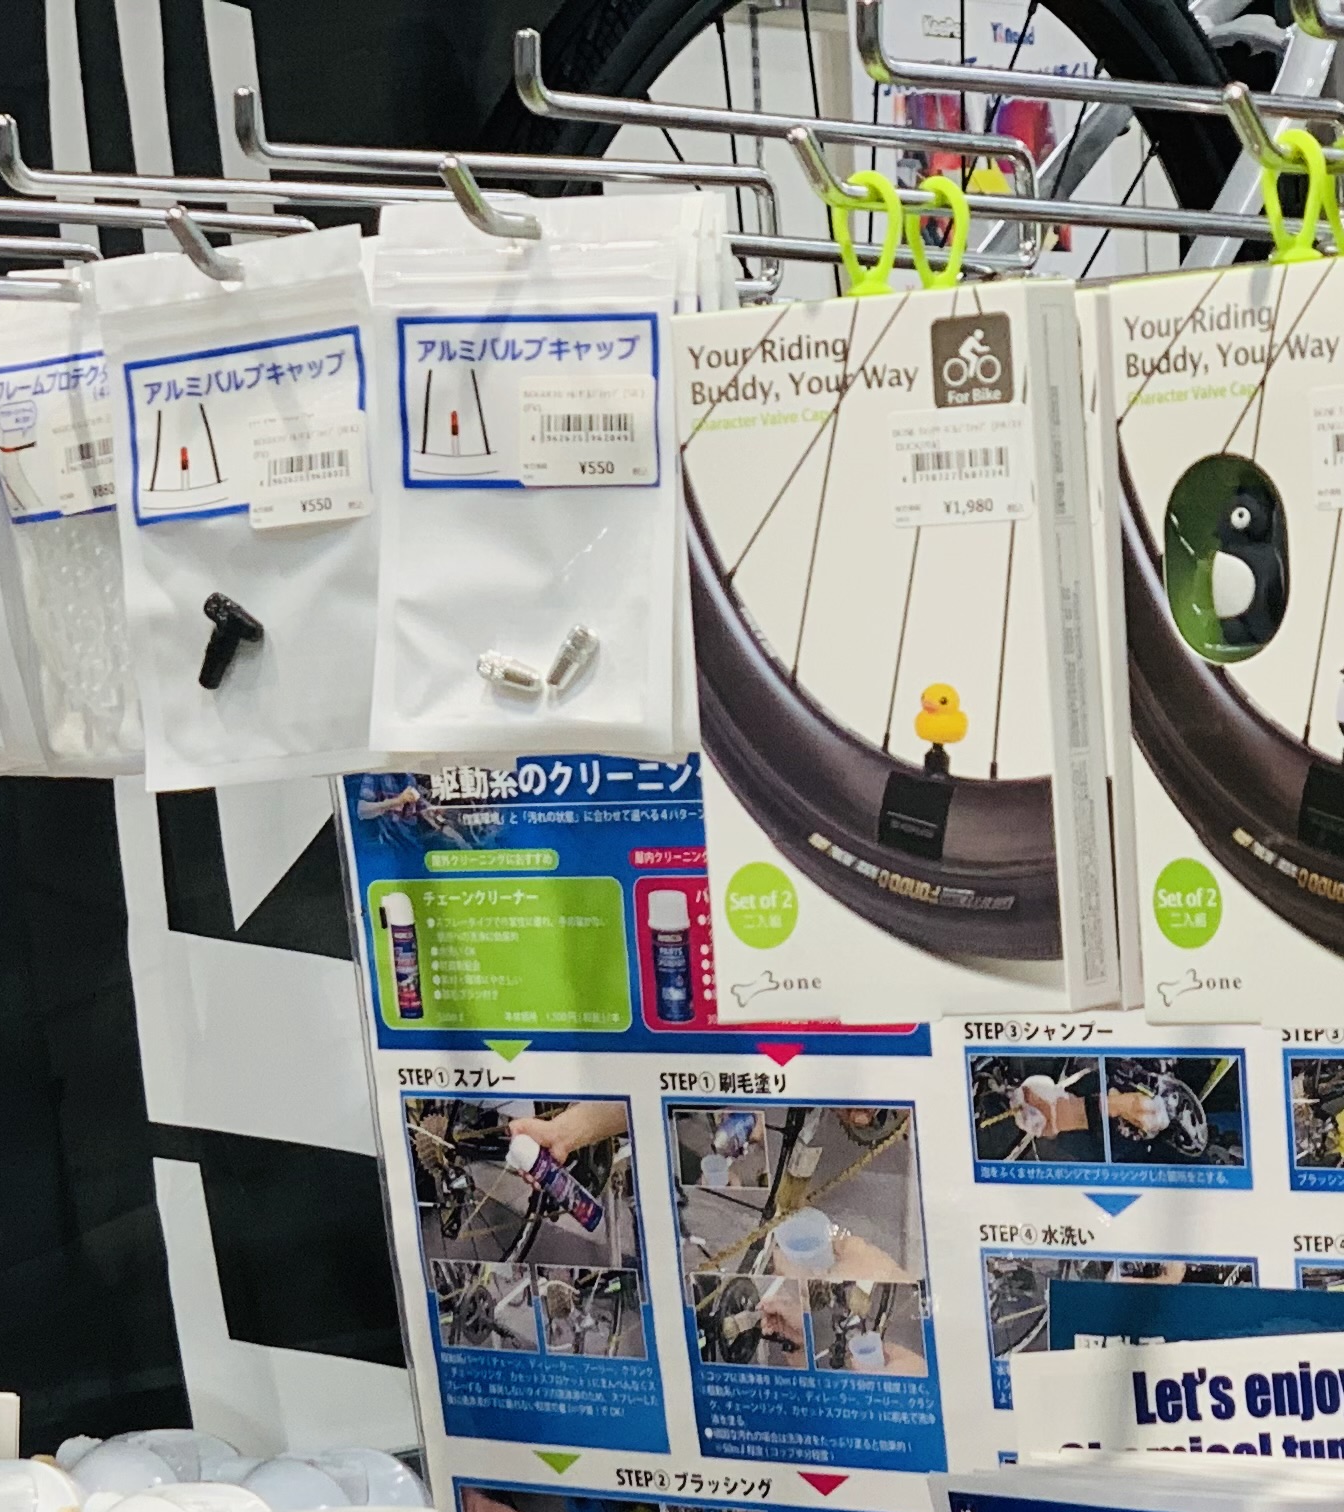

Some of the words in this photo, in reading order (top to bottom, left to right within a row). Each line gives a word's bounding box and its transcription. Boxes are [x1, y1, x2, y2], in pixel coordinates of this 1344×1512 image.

[1124, 316, 1183, 341] Your
[1190, 304, 1273, 332] Riding
[417, 336, 641, 363] アルミバルブキャップ
[688, 345, 753, 371] Your
[759, 337, 849, 364] Riding
[1126, 346, 1210, 378] Buddy,
[1216, 341, 1278, 367] Your
[1284, 335, 1340, 363] Way
[144, 350, 347, 404] アルミバルブキャップ
[691, 376, 781, 405] Buddy,
[789, 371, 855, 396] Your
[862, 364, 919, 390] Way
[947, 390, 968, 404] For
[972, 387, 1002, 403] Bike
[1192, 384, 1229, 400] Valve
[1231, 382, 1256, 399] Cap
[761, 410, 797, 426] Valve
[800, 408, 829, 424] Cap
[579, 461, 615, 475] ¥550
[300, 498, 333, 513] ¥550
[943, 498, 994, 515] ¥1,980
[423, 889, 539, 907] チェーンクリーナー
[730, 893, 758, 911] Set
[762, 893, 779, 910] of
[782, 891, 793, 908] 2
[1158, 891, 1183, 908] Set
[1186, 888, 1202, 907] of
[1205, 888, 1217, 906] 2
[1132, 1367, 1234, 1426] Let's
